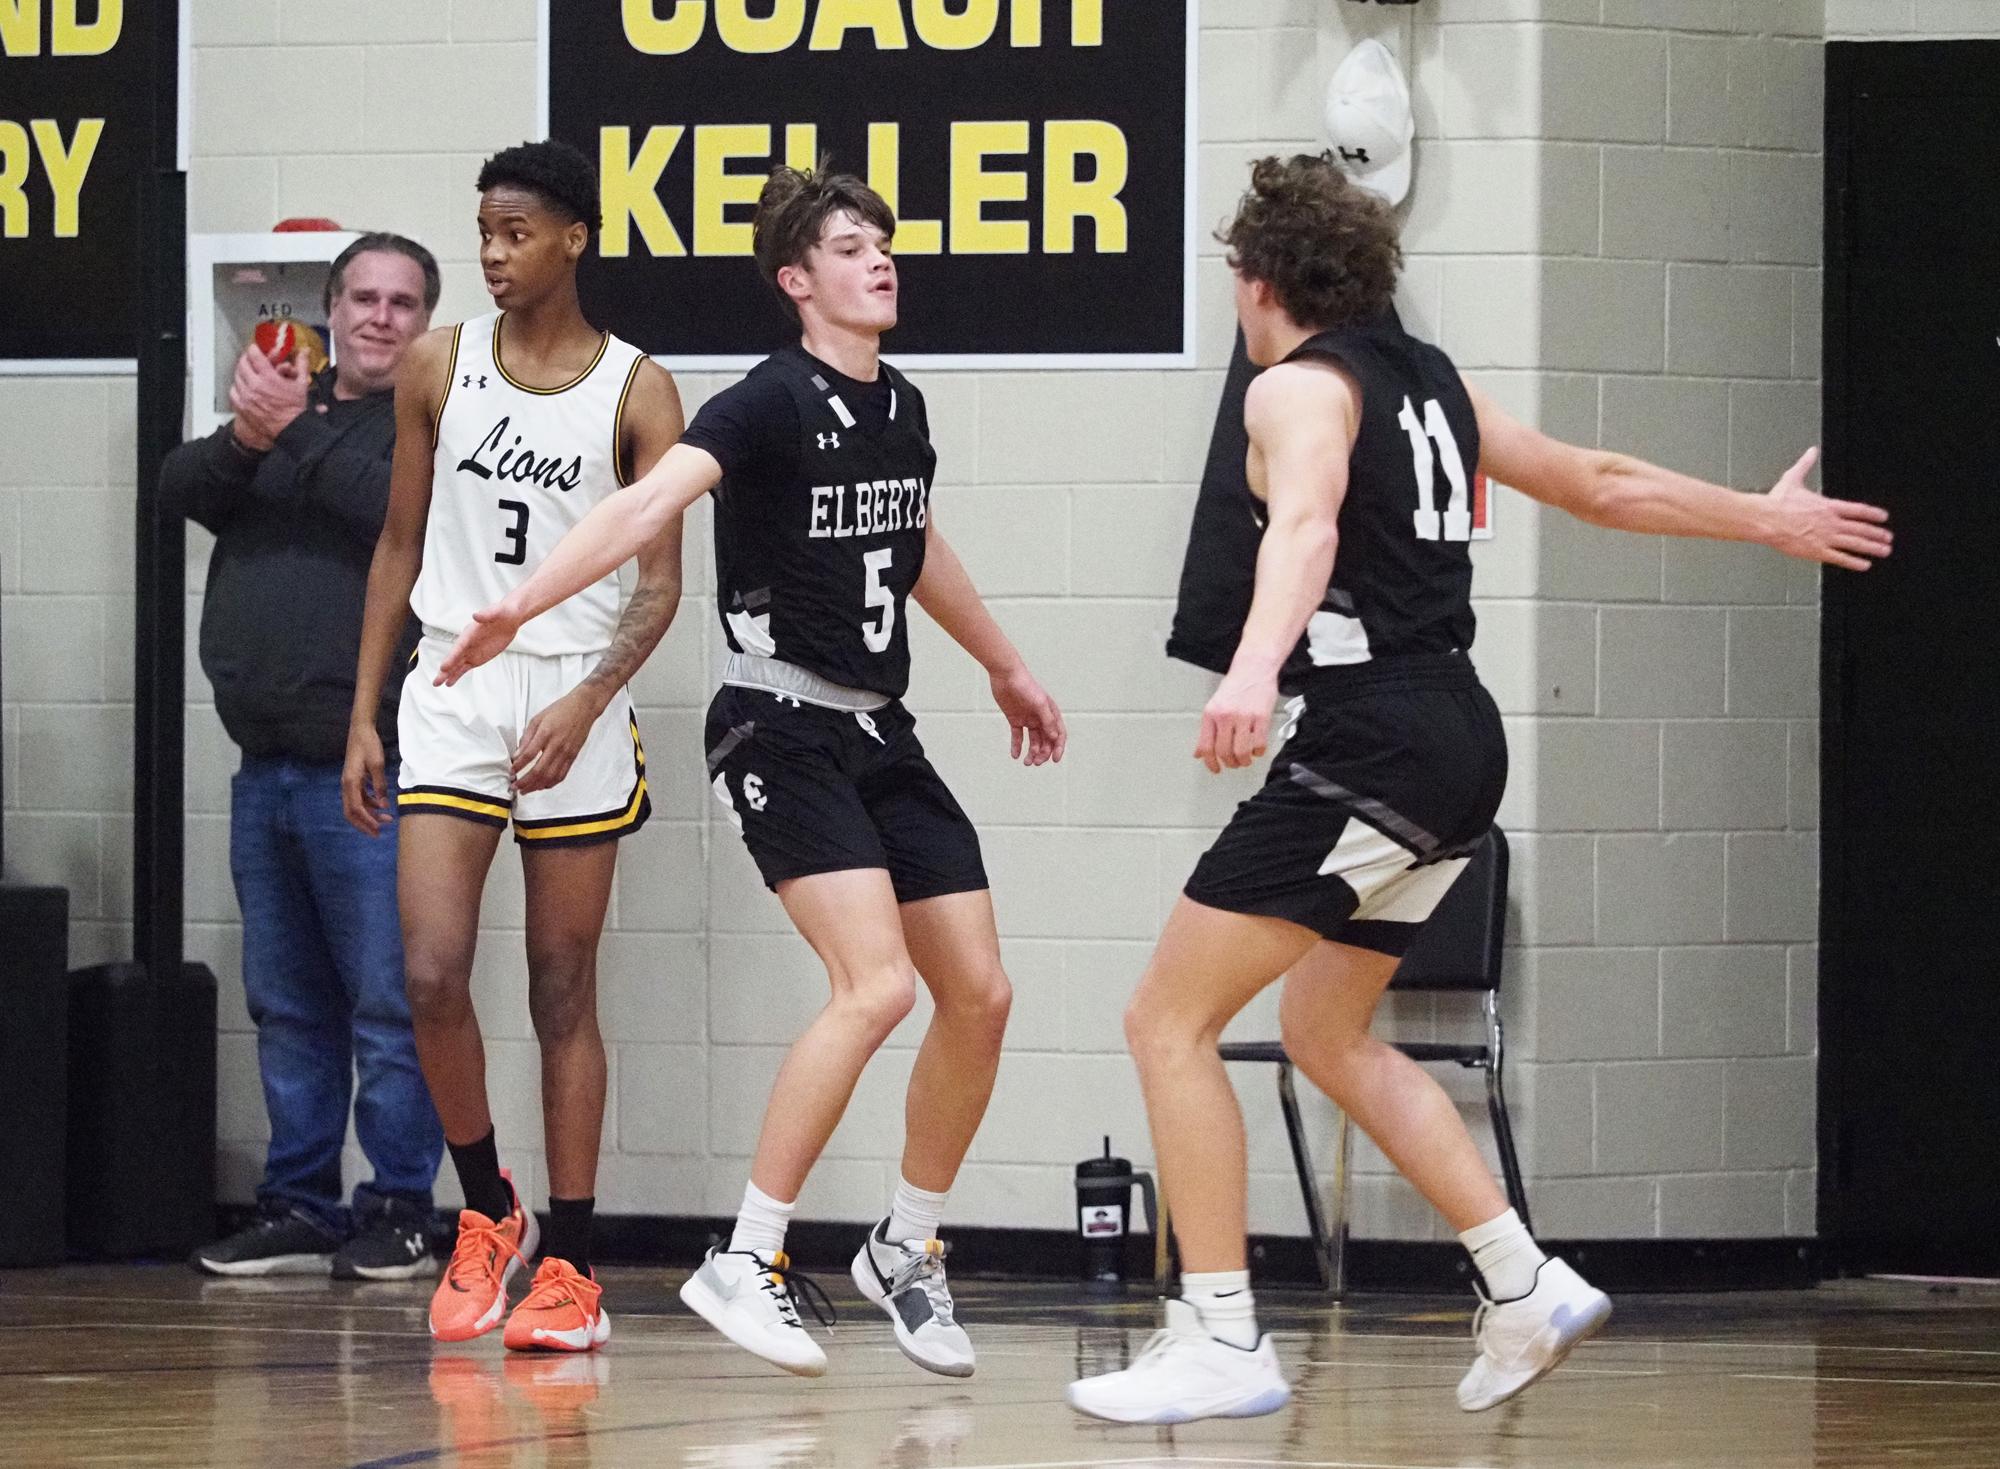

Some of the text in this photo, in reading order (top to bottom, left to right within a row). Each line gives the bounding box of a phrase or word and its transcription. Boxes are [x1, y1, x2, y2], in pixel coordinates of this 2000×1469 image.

[600, 120, 1128, 257] KELER
[456, 416, 582, 492] Lions
[1397, 394, 1471, 541] 11
[494, 498, 530, 566] 3
[862, 547, 895, 653] 5
